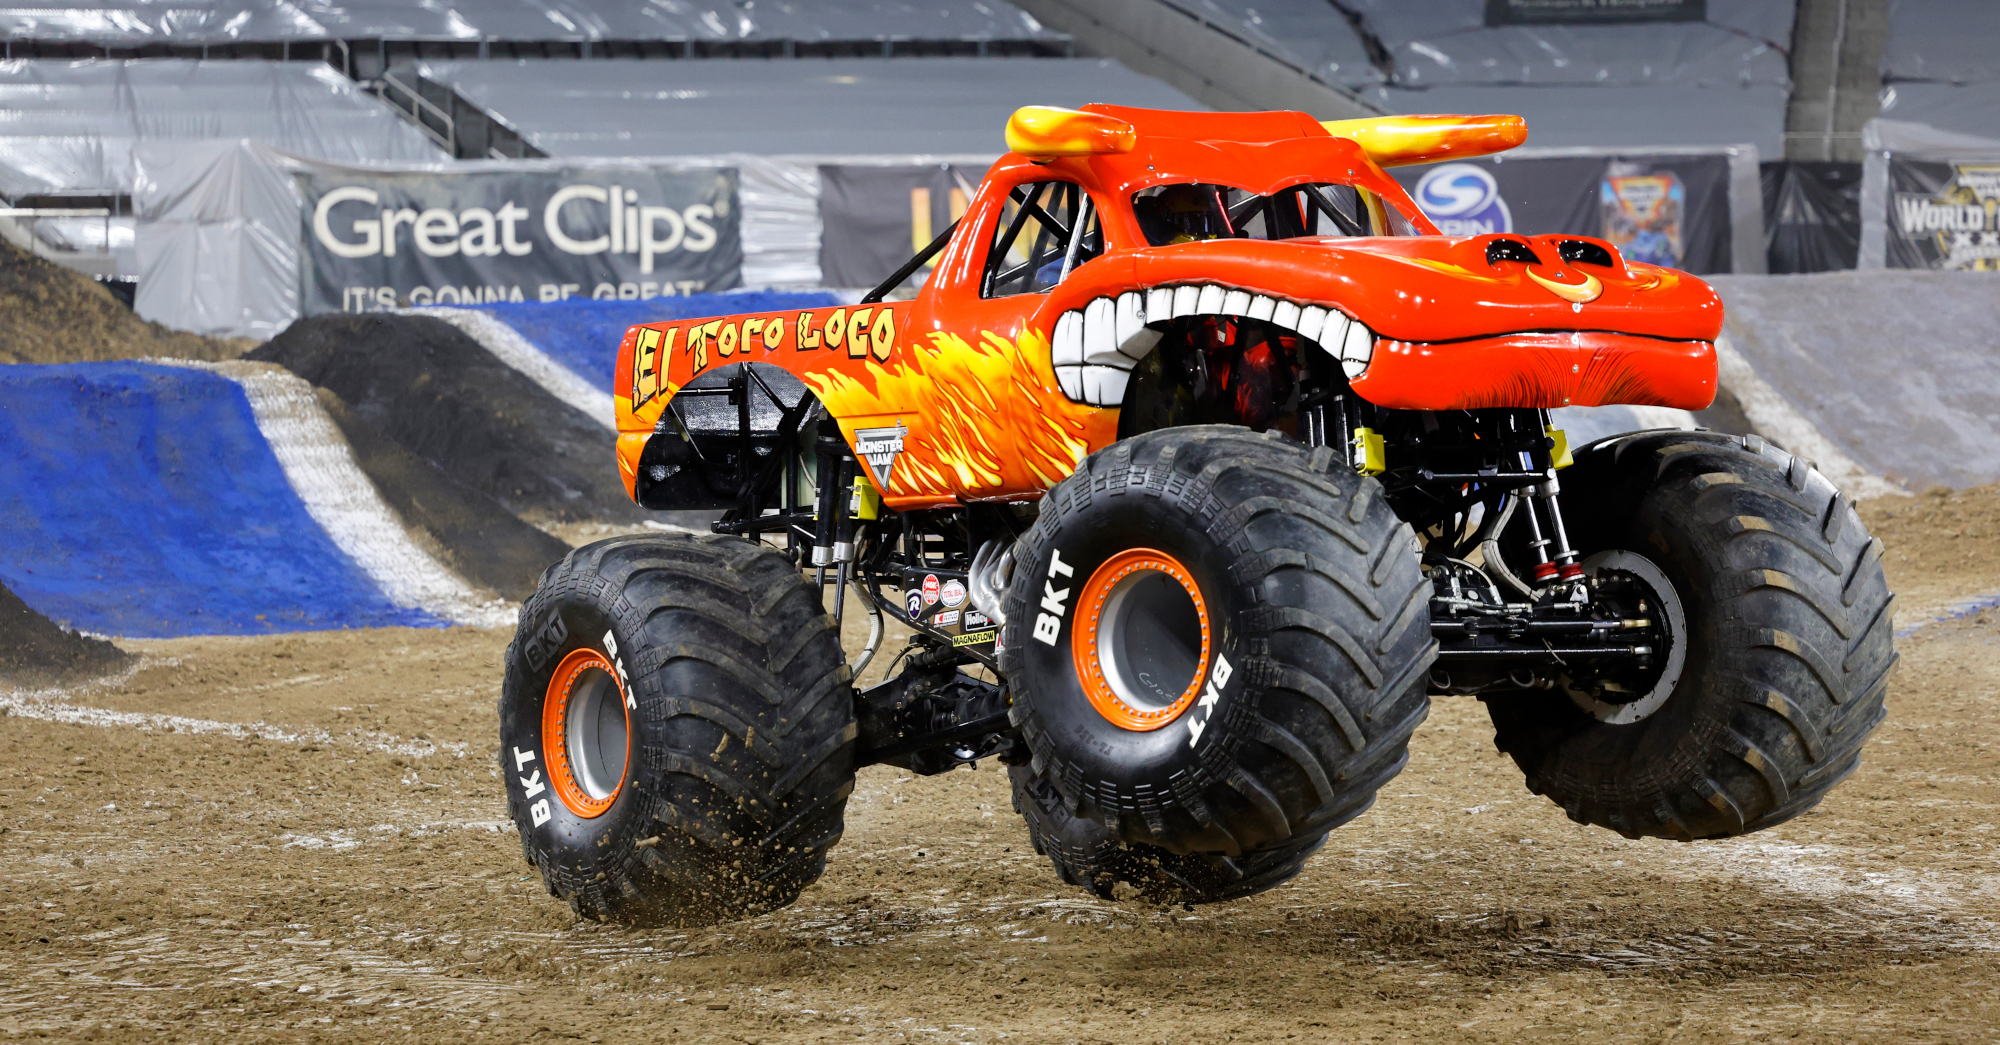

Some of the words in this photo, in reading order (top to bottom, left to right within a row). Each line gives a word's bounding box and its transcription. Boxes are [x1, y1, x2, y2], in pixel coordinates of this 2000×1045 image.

[313, 186, 532, 258] Great
[544, 184, 718, 275] Clips
[343, 286, 396, 312] IT'S
[855, 439, 904, 454] MONSTER
[870, 453, 893, 466] JAM
[966, 613, 988, 627] Holley
[1033, 548, 1075, 647] BKT
[527, 610, 568, 671] BKT
[953, 631, 994, 646] MAGNAFLOW
[602, 629, 638, 711] BKT
[1187, 652, 1234, 749] BKT
[513, 746, 552, 829] BKT
